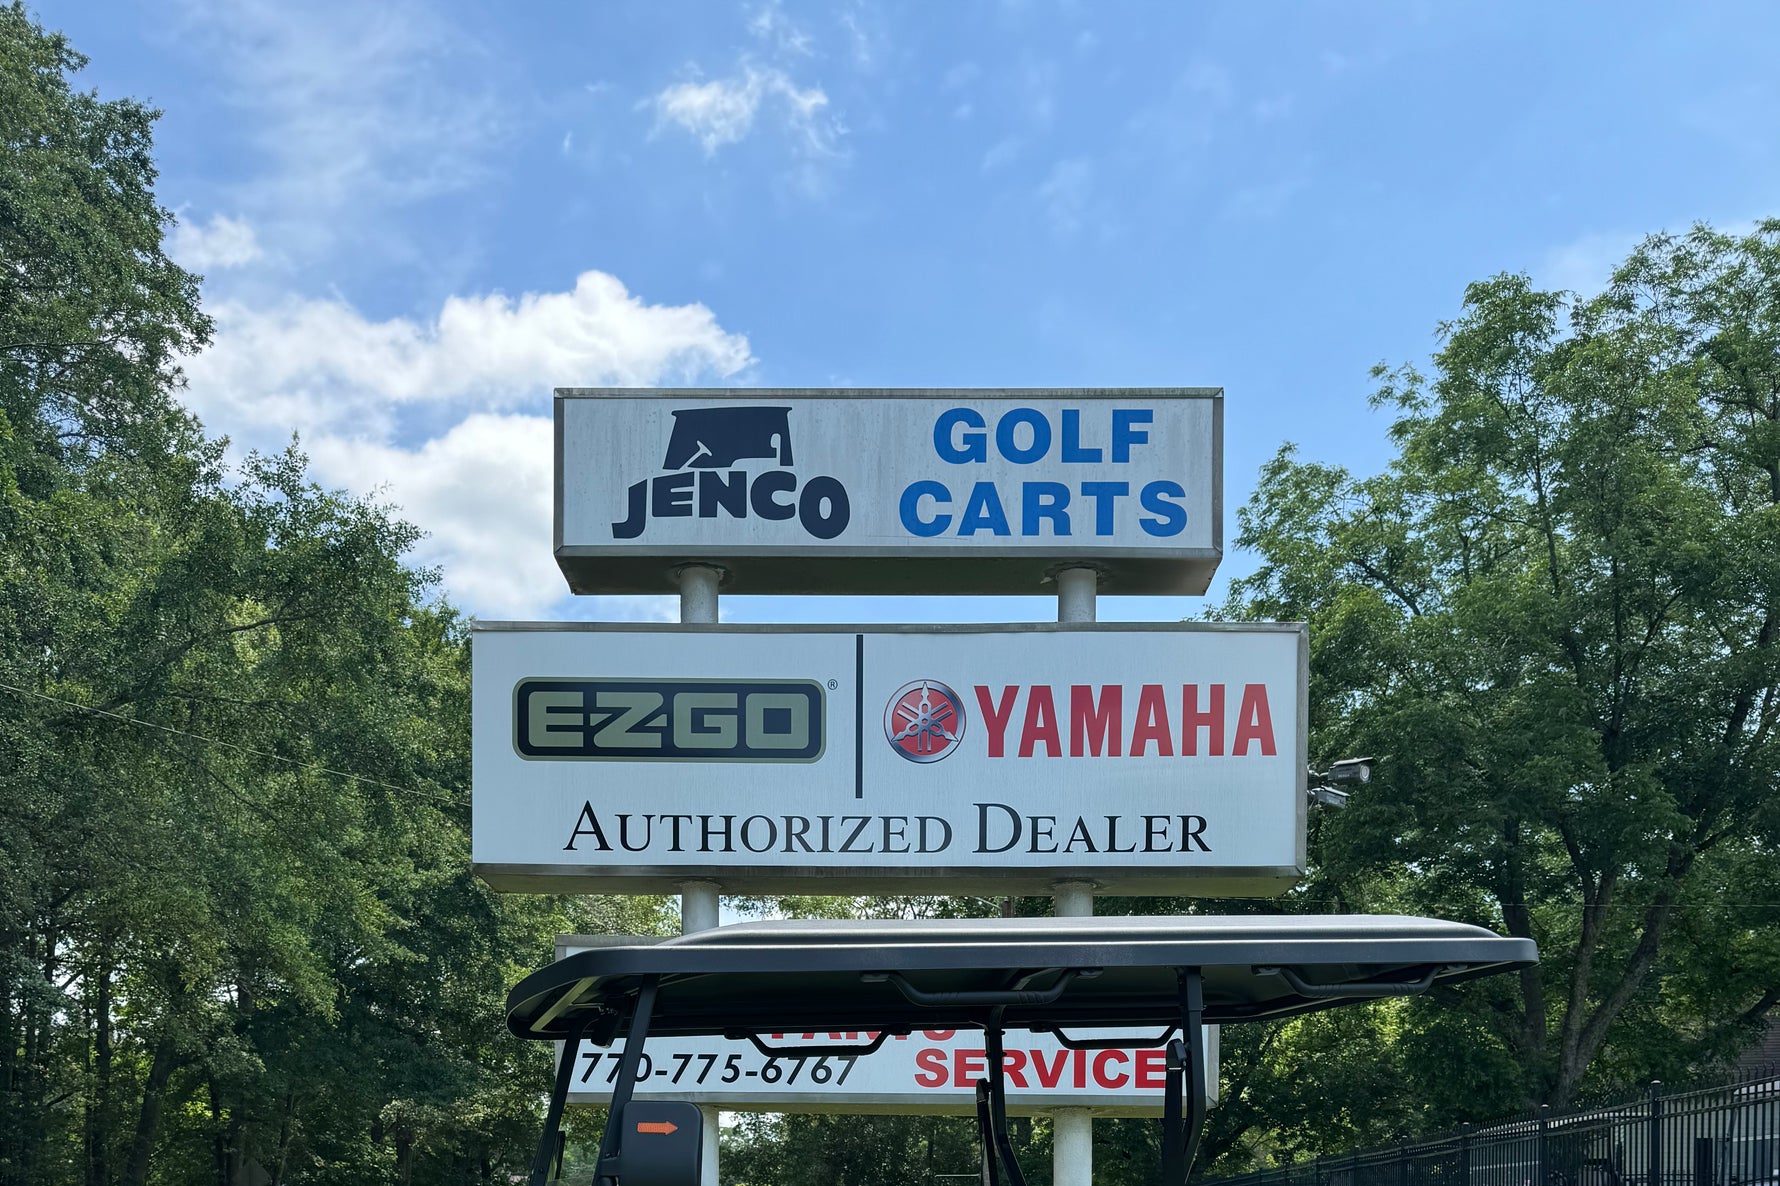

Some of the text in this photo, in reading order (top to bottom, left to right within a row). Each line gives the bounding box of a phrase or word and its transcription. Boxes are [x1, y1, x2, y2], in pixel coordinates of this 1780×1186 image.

[933, 407, 1154, 465] GOLF
[611, 470, 851, 540] JENCO
[899, 480, 1188, 538] CARTS
[974, 684, 1277, 757] YAMAHA
[562, 800, 1213, 854] AUTHORIZED DEALER
[580, 1052, 859, 1086] 770-775-6767
[914, 1048, 1167, 1089] SERVICE
